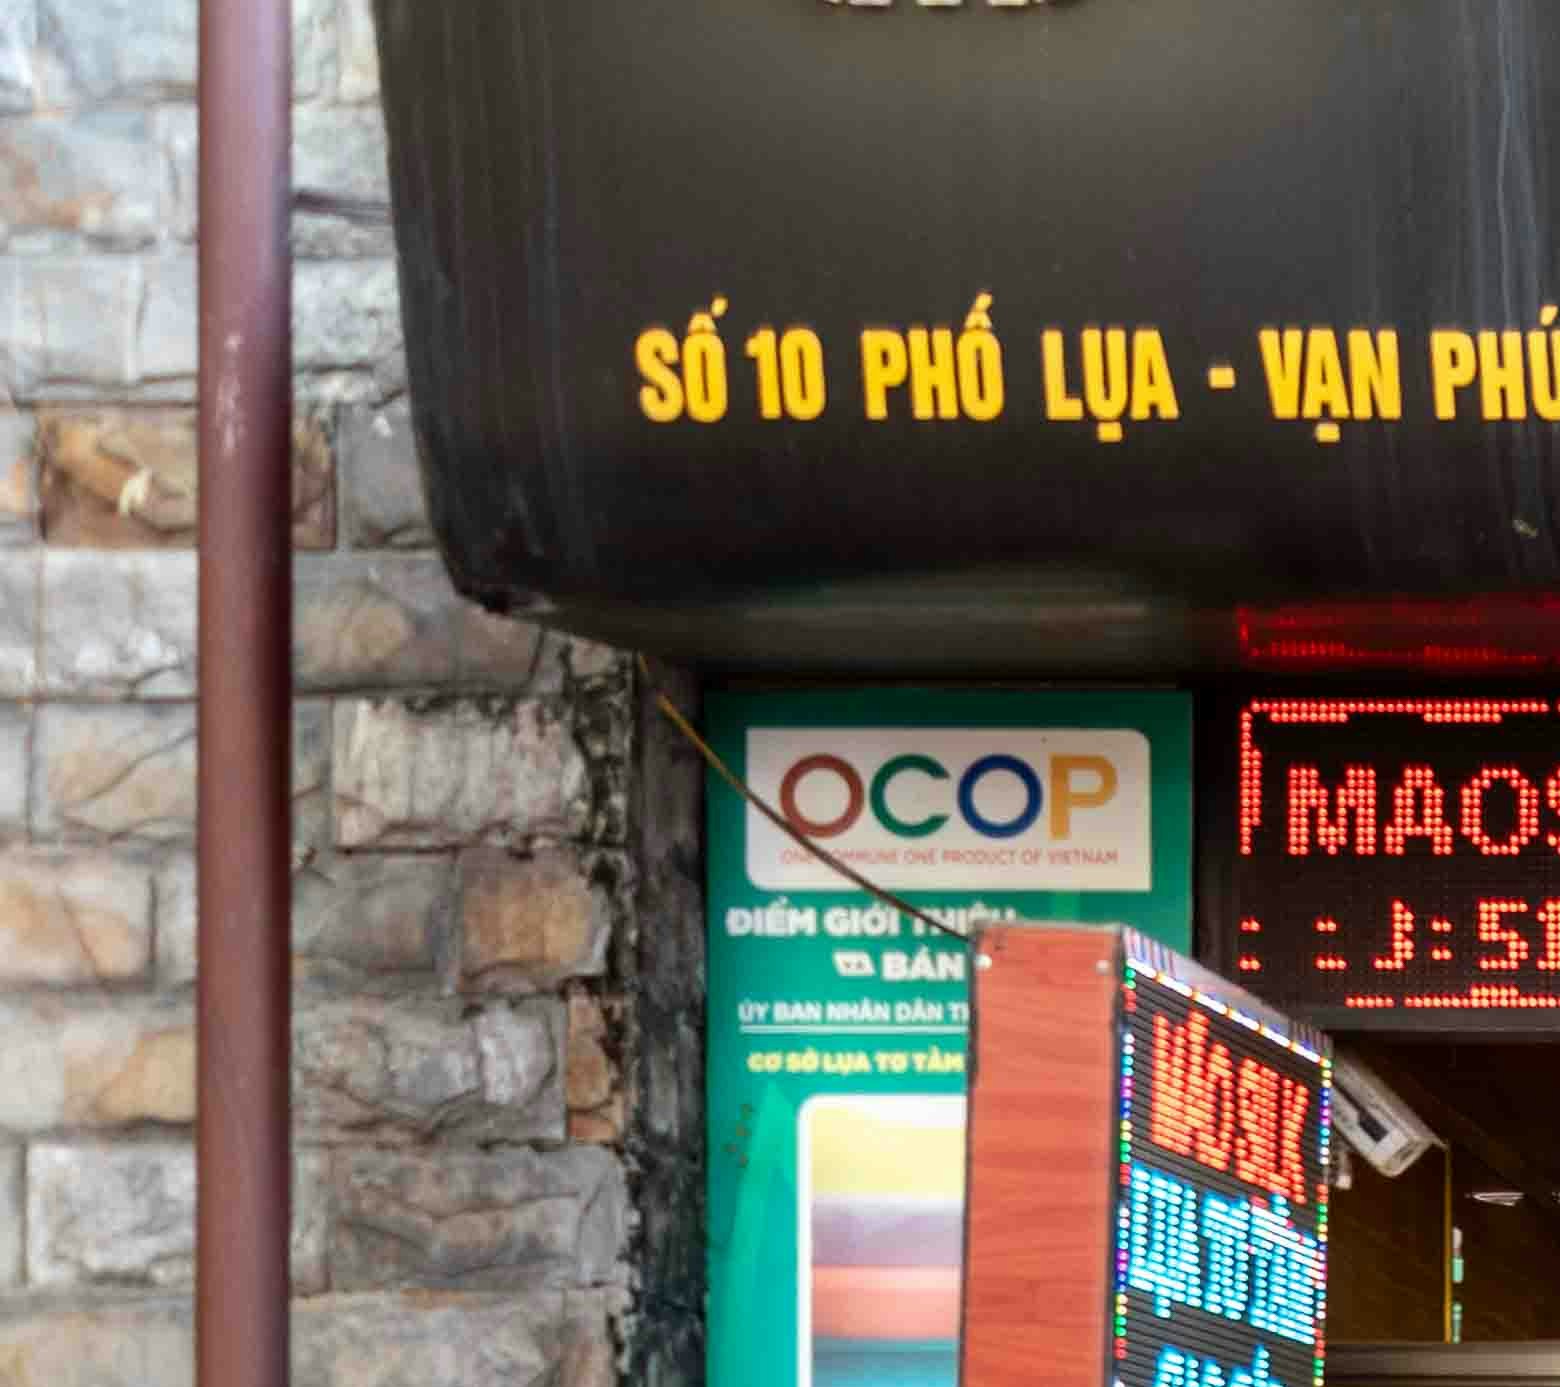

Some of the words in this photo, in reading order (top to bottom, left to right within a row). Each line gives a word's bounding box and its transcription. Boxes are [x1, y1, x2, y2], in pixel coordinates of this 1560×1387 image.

[635, 297, 728, 422] SỐ
[745, 327, 826, 421] 10
[860, 292, 1005, 421] PHỐ
[1041, 328, 1180, 442] LỤA
[1258, 328, 1402, 442] VẠN
[779, 753, 1118, 840] OCOP
[882, 945, 966, 981] BÁN
